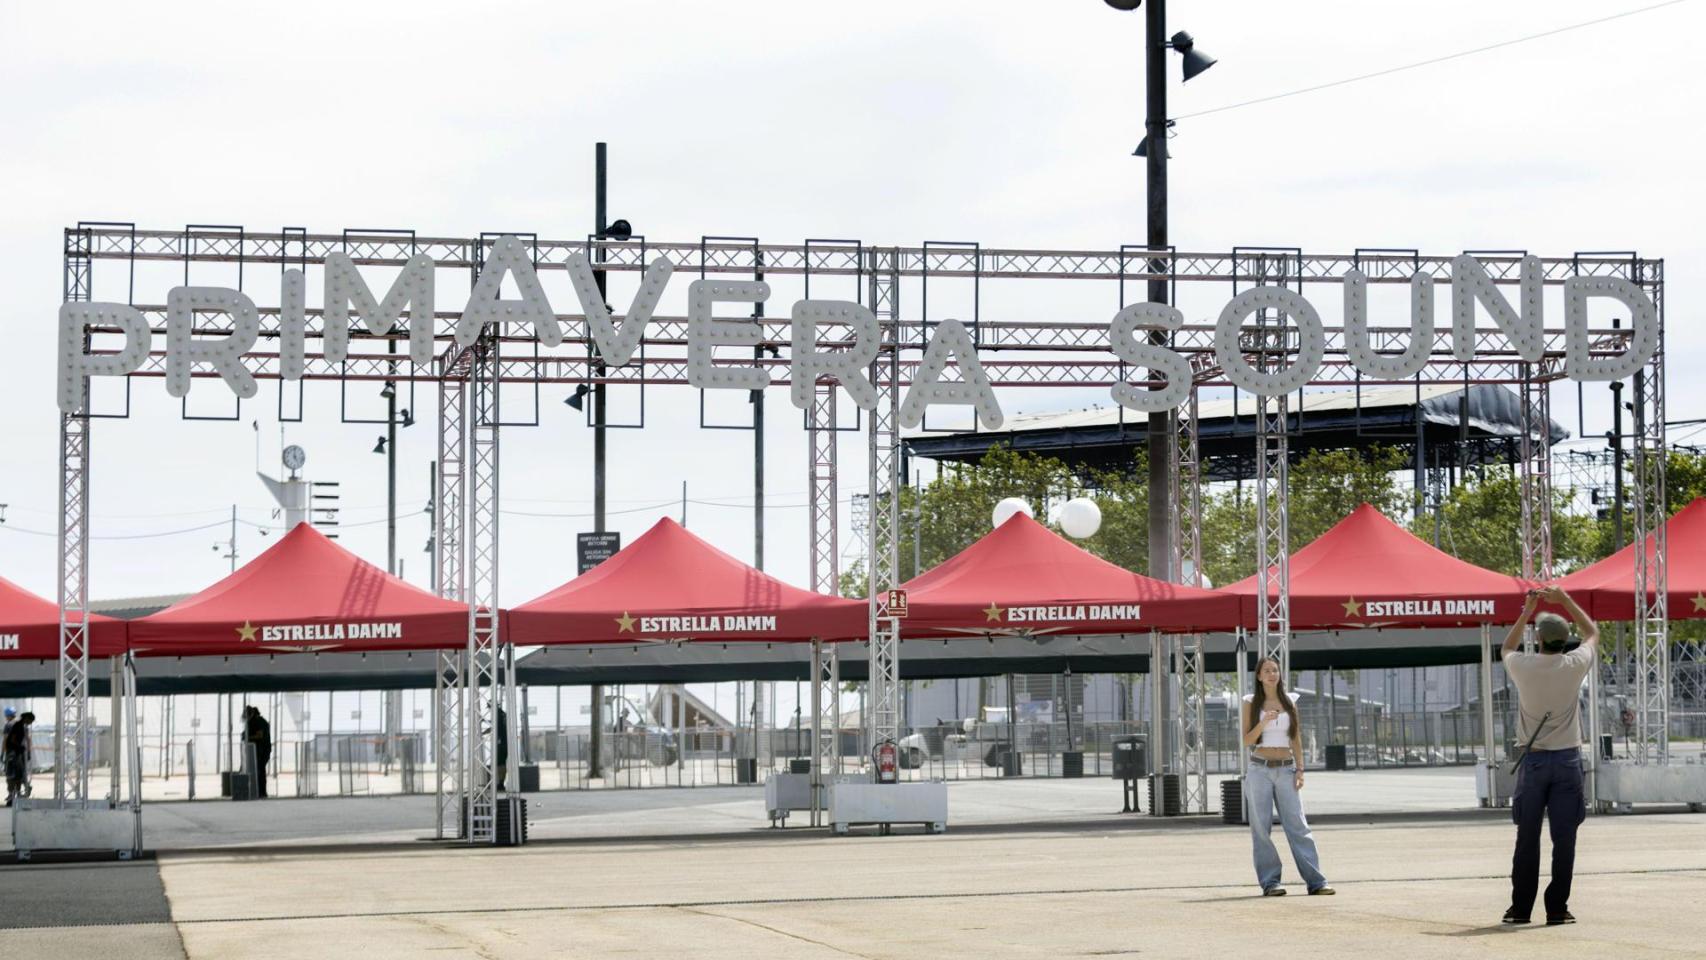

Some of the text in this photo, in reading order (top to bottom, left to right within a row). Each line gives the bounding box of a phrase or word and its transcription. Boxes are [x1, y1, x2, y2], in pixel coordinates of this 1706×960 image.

[57, 235, 1658, 431] PRIMAVERA SOUND
[1008, 605, 1140, 621] ESTRELLA DAMM
[1366, 600, 1495, 616] ESTRELLA DAMM
[262, 623, 402, 641] ESTRELLA DAMM
[640, 616, 776, 632] ESTRELLA DAMM
